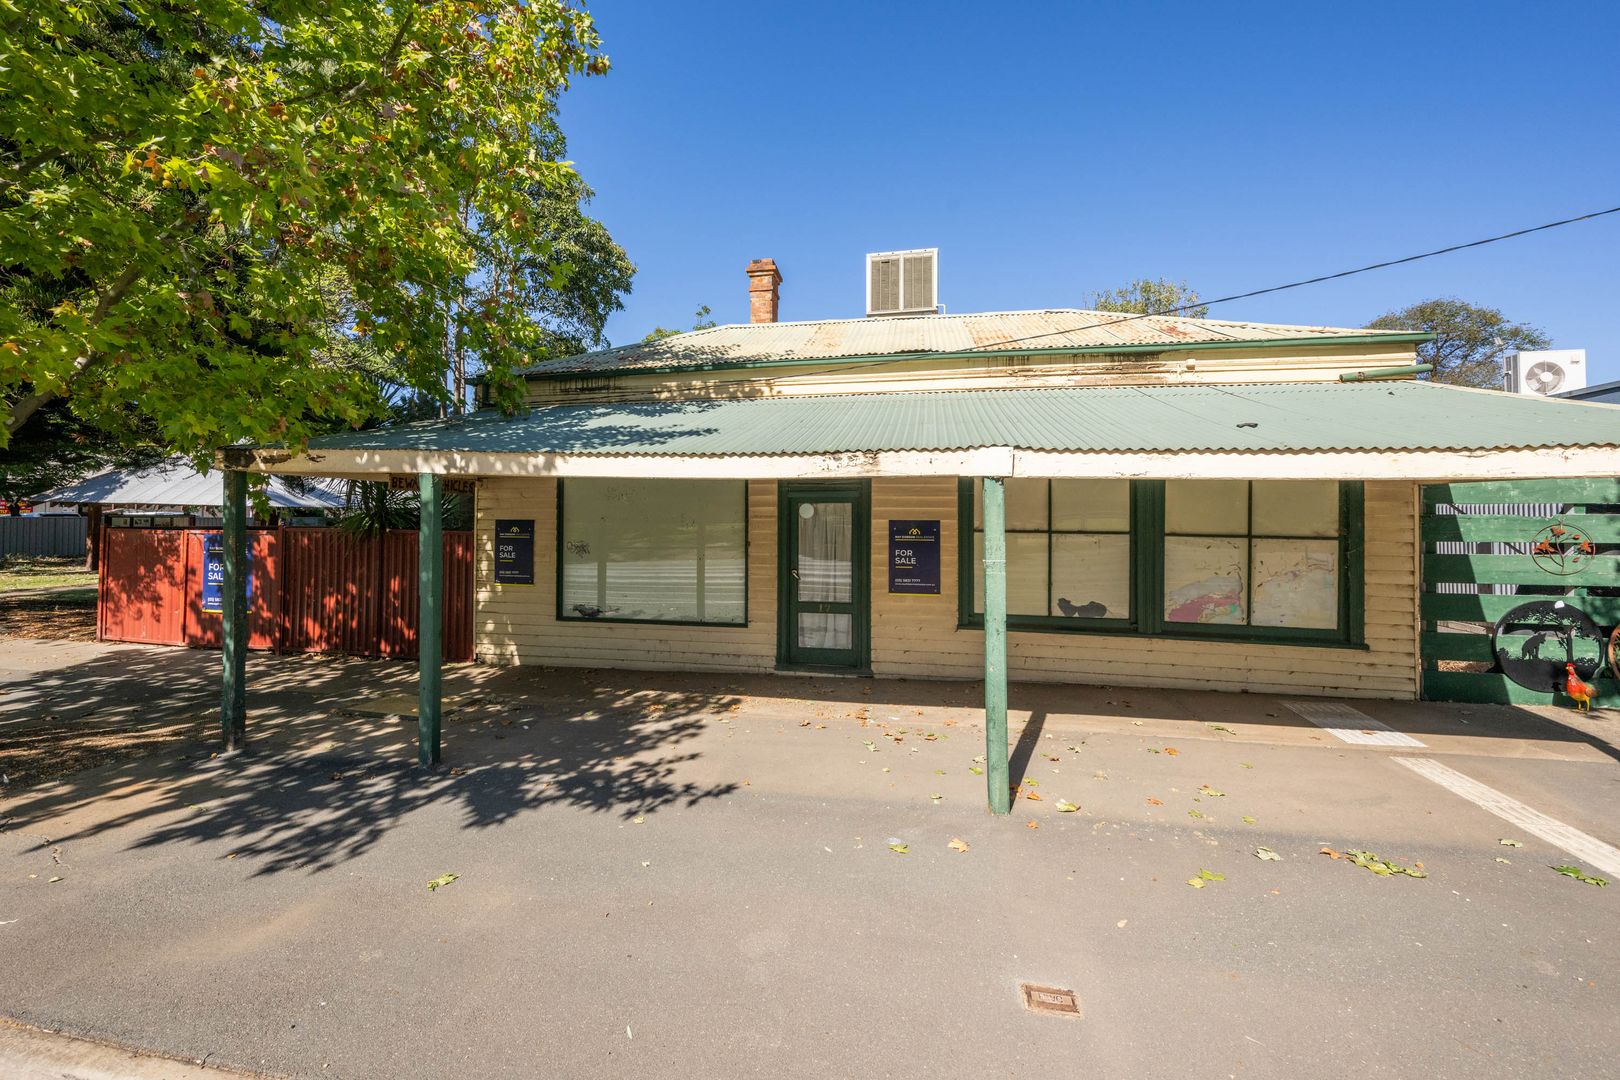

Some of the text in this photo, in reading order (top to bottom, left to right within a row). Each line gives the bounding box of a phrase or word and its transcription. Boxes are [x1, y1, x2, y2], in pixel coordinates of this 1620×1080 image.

[391, 476, 475, 493] BEWA HICLES
[499, 551, 516, 559] SALE
[895, 549, 913, 557] FOR
[895, 557, 917, 565] SALE
[207, 572, 224, 581] SAL
